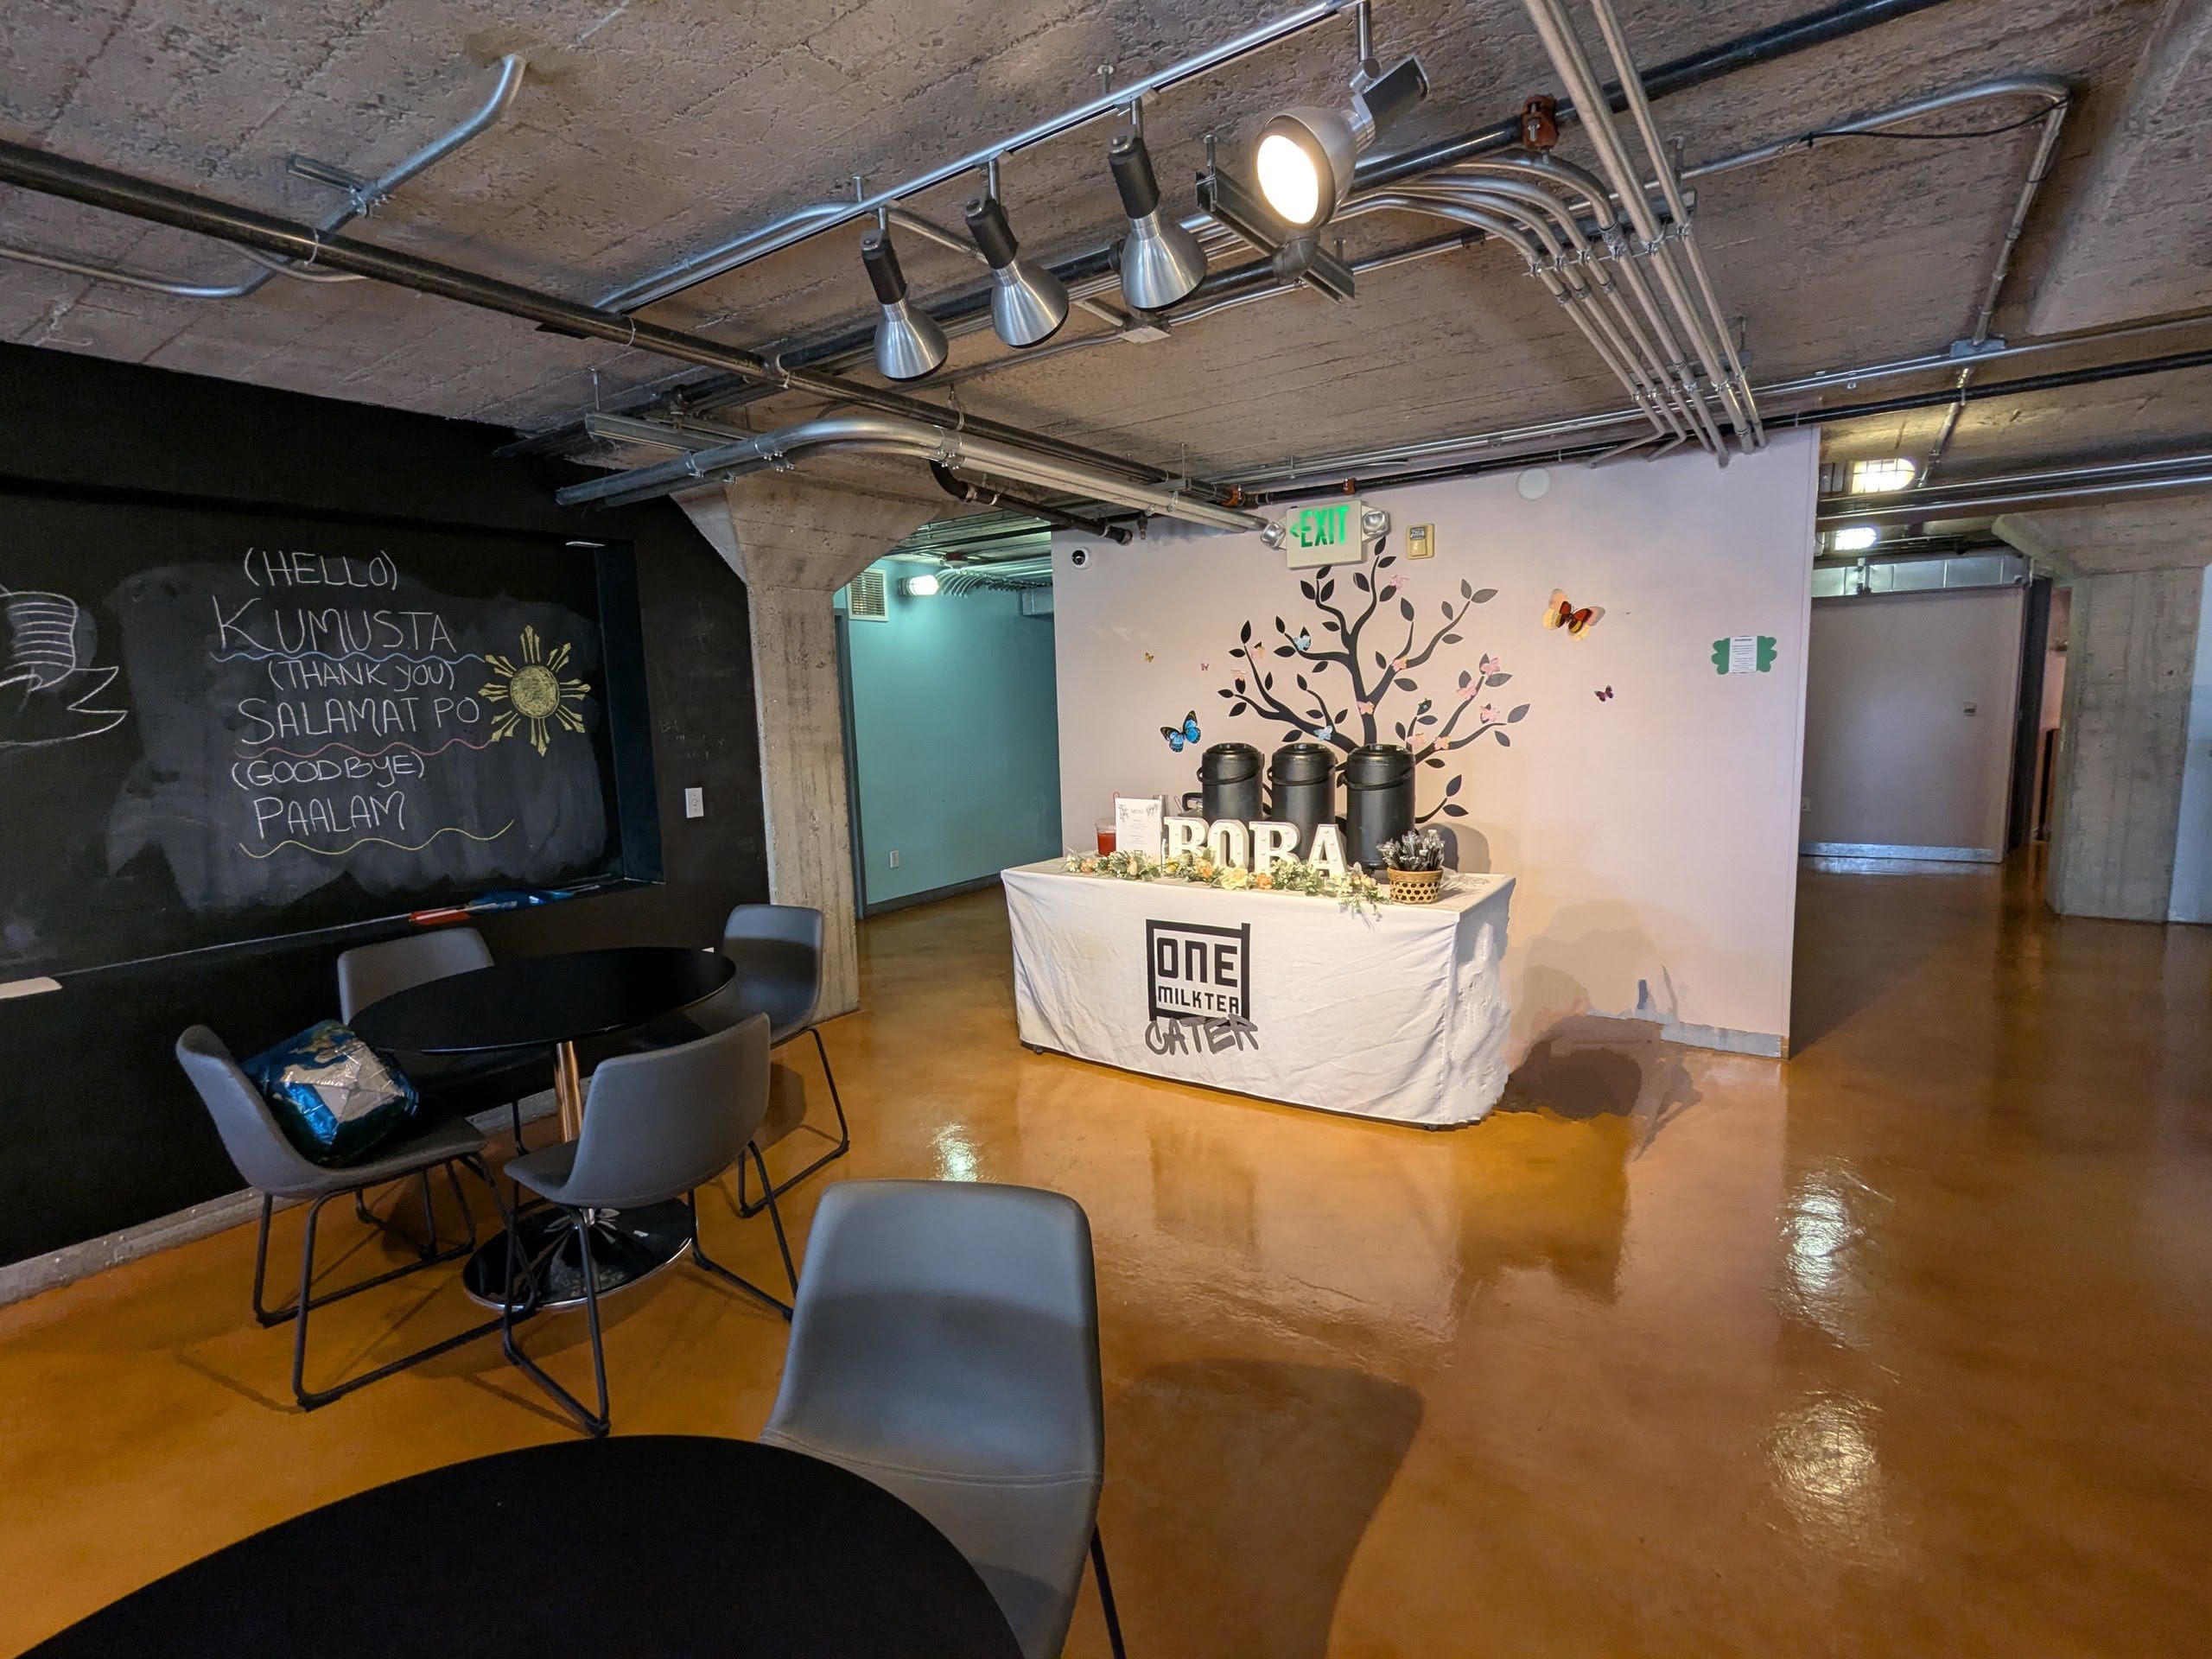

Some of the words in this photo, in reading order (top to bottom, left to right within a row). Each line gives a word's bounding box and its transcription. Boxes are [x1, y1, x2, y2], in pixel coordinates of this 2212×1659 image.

[1300, 505, 1350, 548] EXIT
[244, 547, 397, 591] (HELLO)
[213, 594, 457, 653] KUMUSTA
[267, 661, 391, 690] (THANK
[238, 696, 420, 744] SALAMAT
[434, 696, 480, 728] PO
[231, 751, 425, 790] (GOODBYE)
[253, 791, 406, 839] PAALAM
[1164, 817, 1348, 880] BOBA
[1157, 937, 1238, 988] ONE
[1158, 985, 1240, 1015] MILKTEA
[1145, 1014, 1259, 1056] CATER
